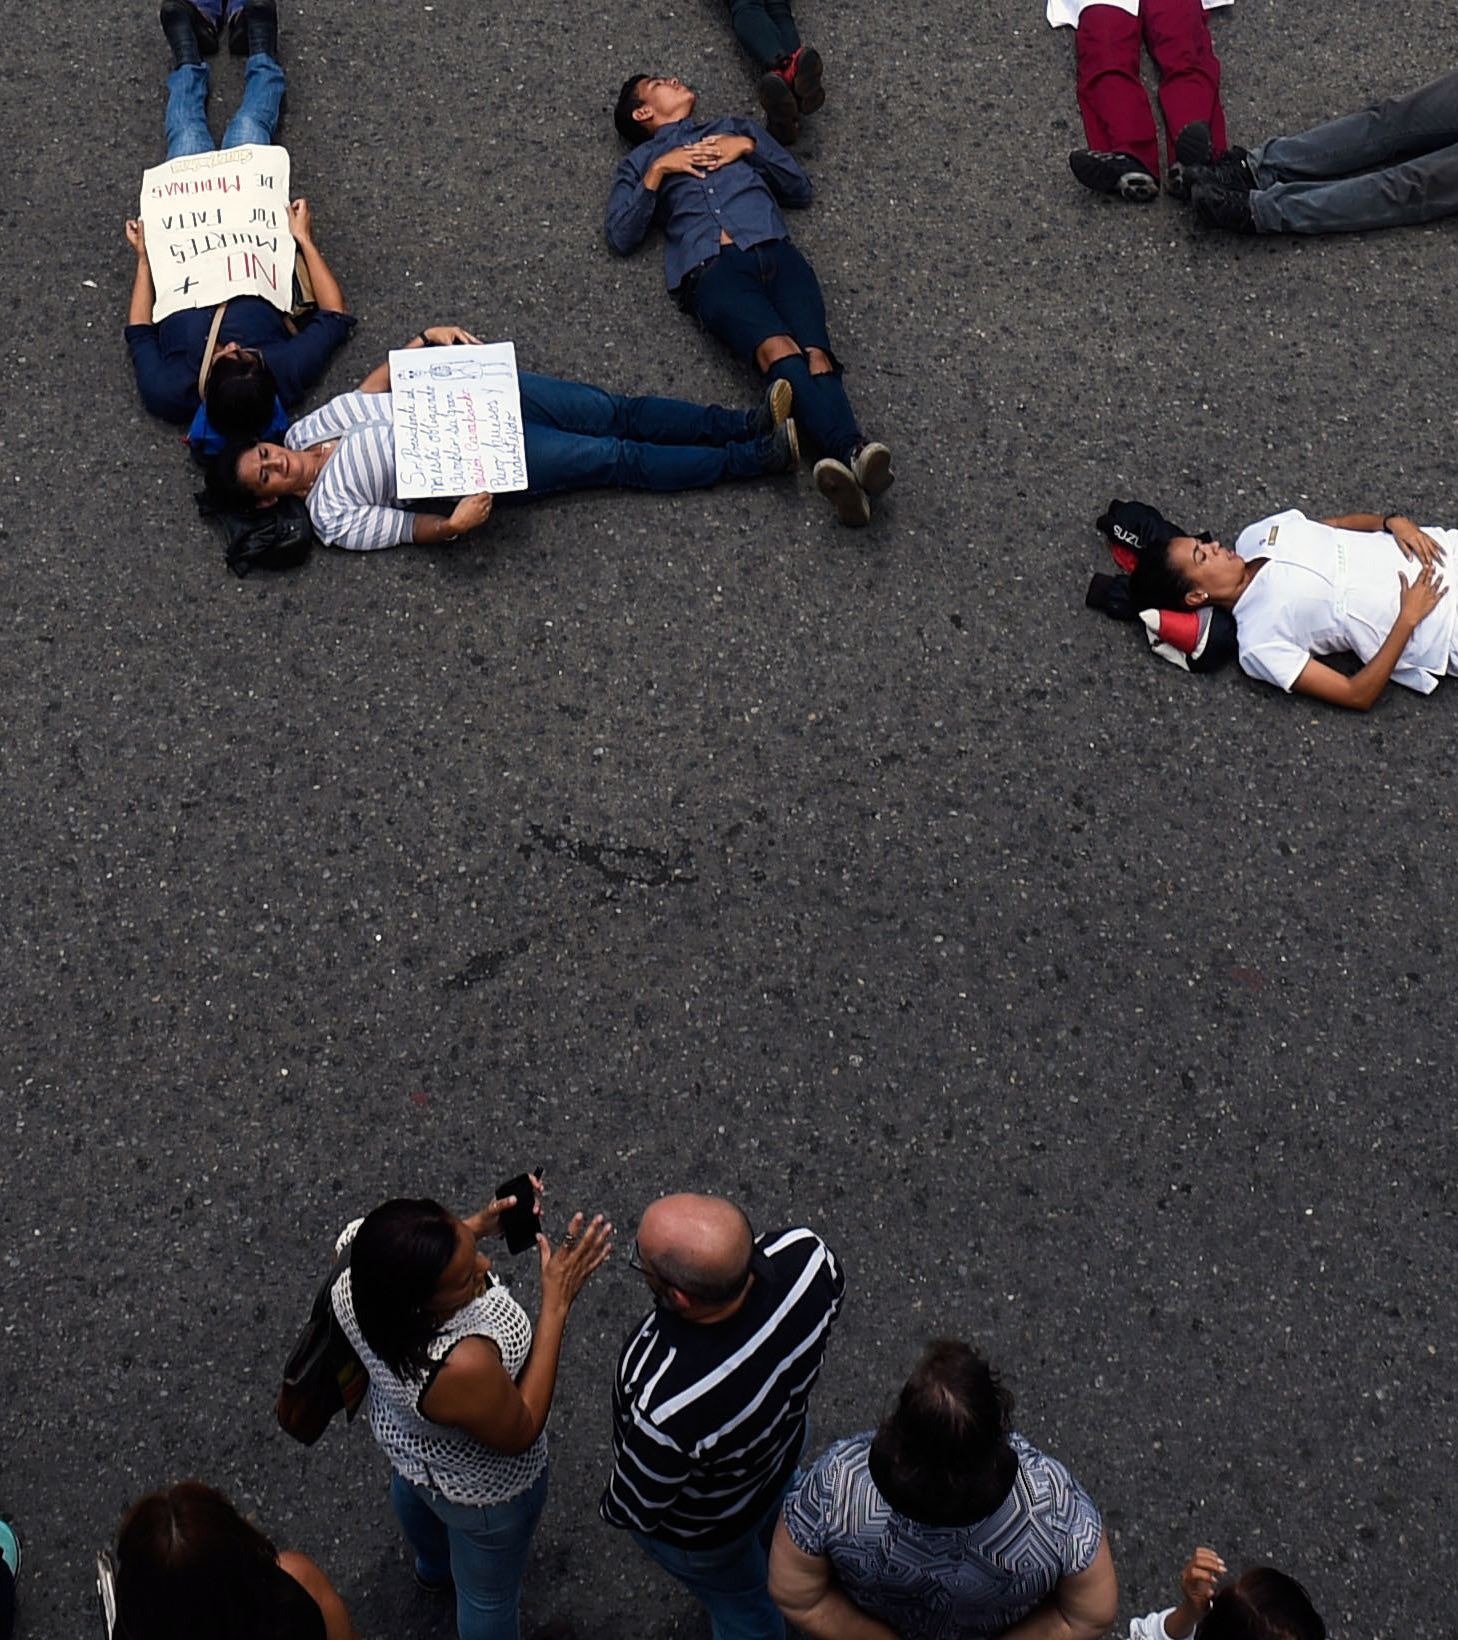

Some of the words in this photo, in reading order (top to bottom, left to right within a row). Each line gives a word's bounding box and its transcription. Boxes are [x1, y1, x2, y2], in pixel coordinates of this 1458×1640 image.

[151, 175, 241, 198] MEDICINAS
[255, 173, 274, 190] DE
[161, 208, 222, 230] FALTA
[170, 232, 277, 265] MUERTES
[227, 251, 277, 291] NO
